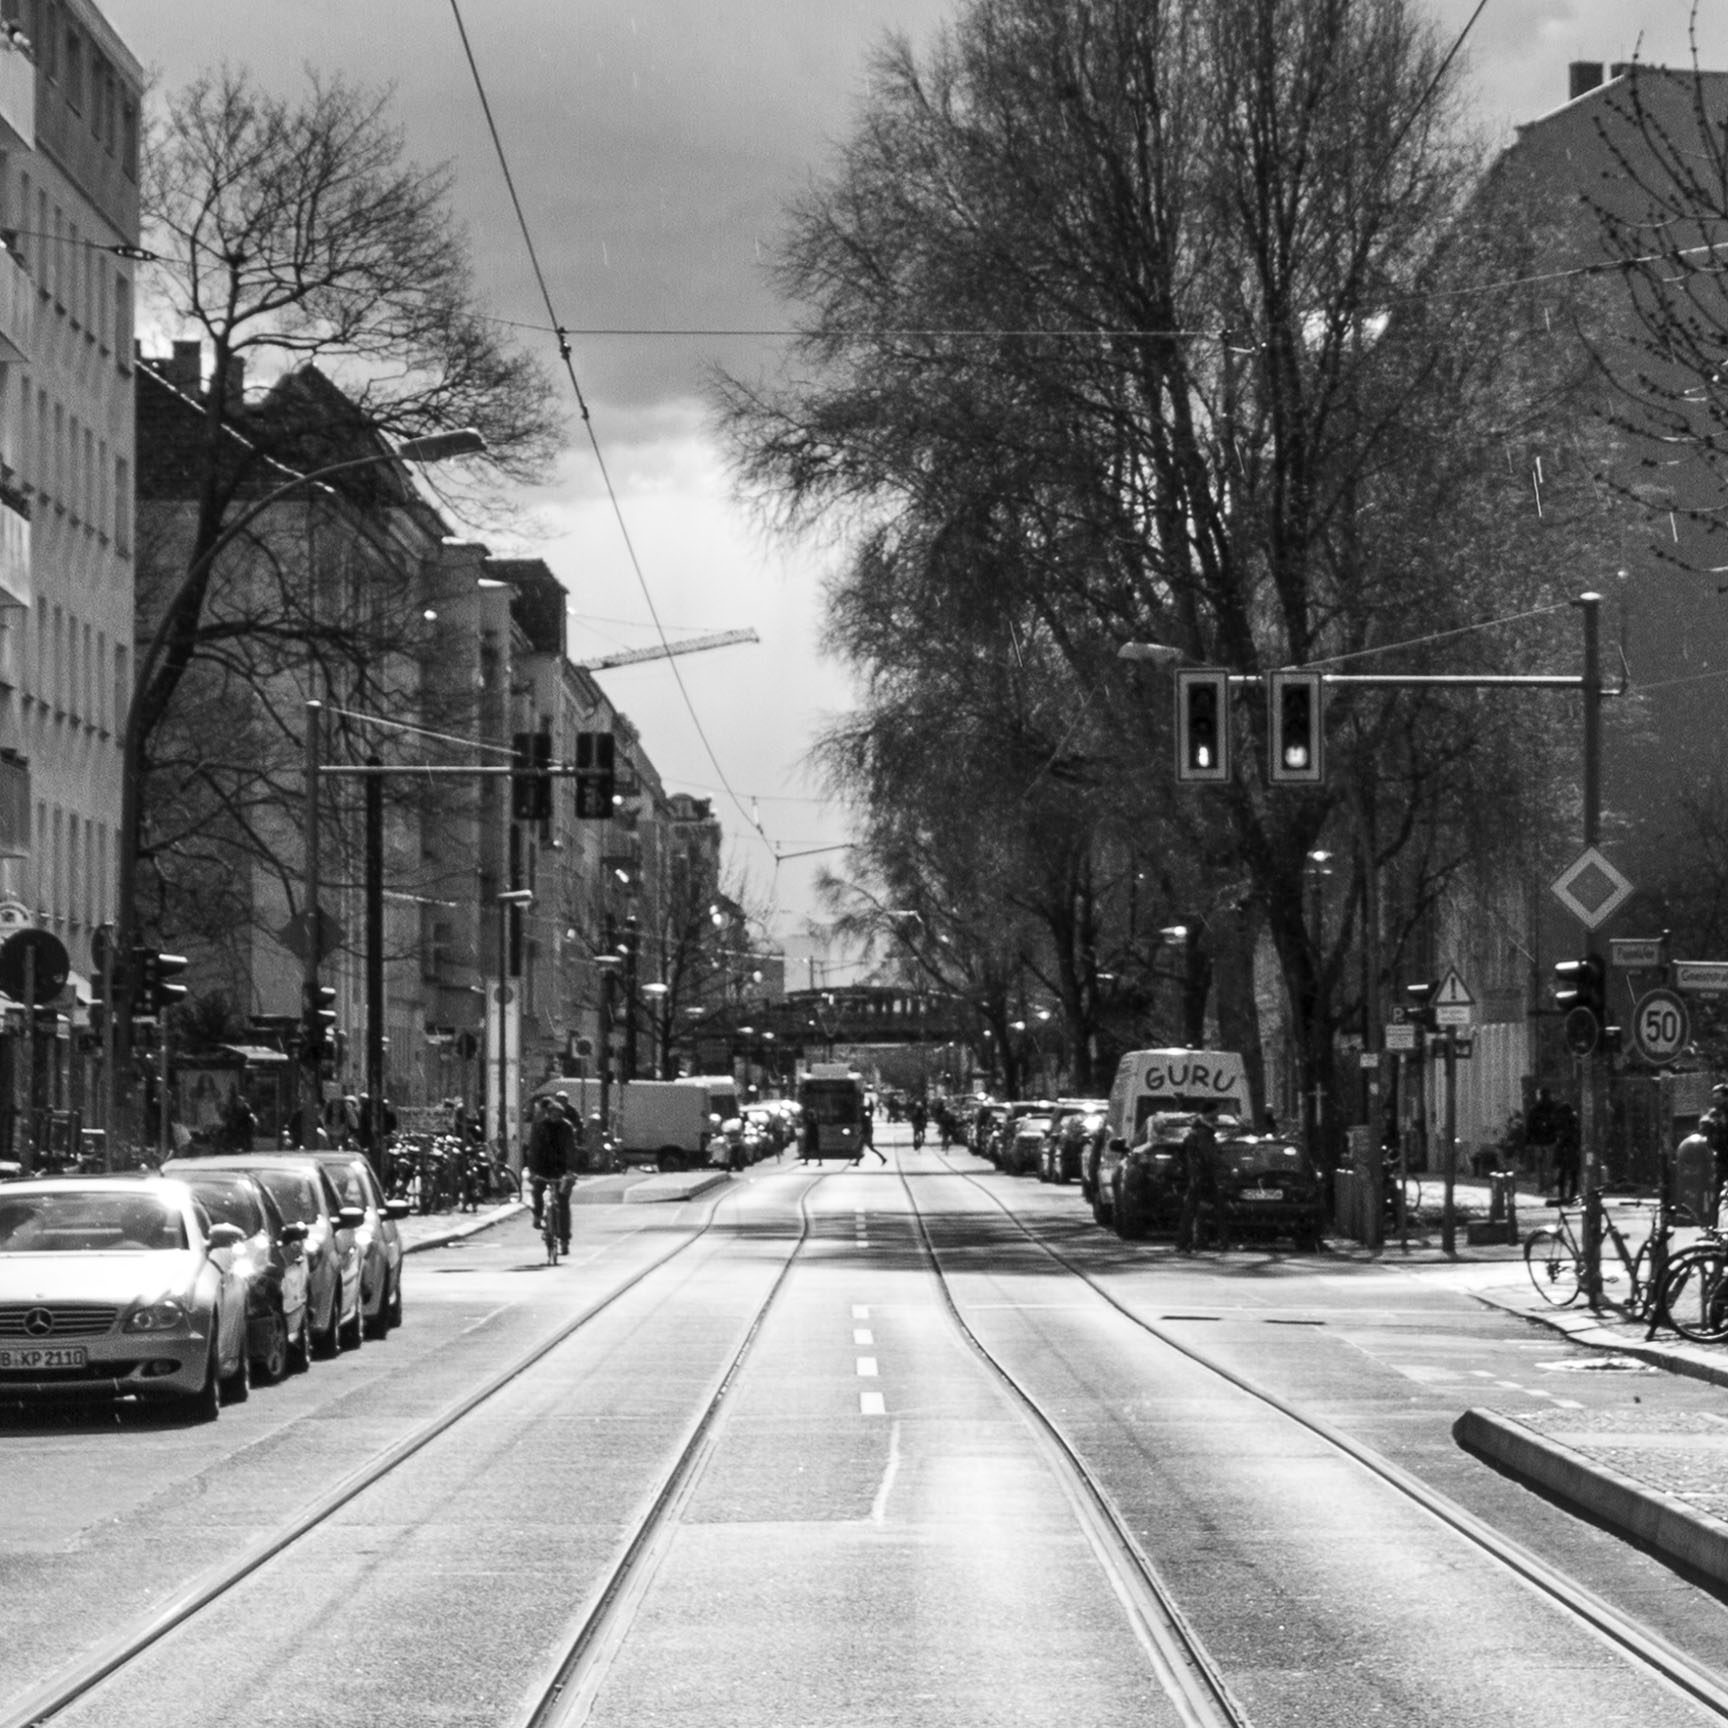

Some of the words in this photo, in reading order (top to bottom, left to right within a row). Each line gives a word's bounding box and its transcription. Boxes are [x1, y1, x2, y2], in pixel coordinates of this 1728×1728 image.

[1646, 1011, 1677, 1043] 50
[1145, 1064, 1236, 1092] GURU
[0, 1352, 11, 1366] B
